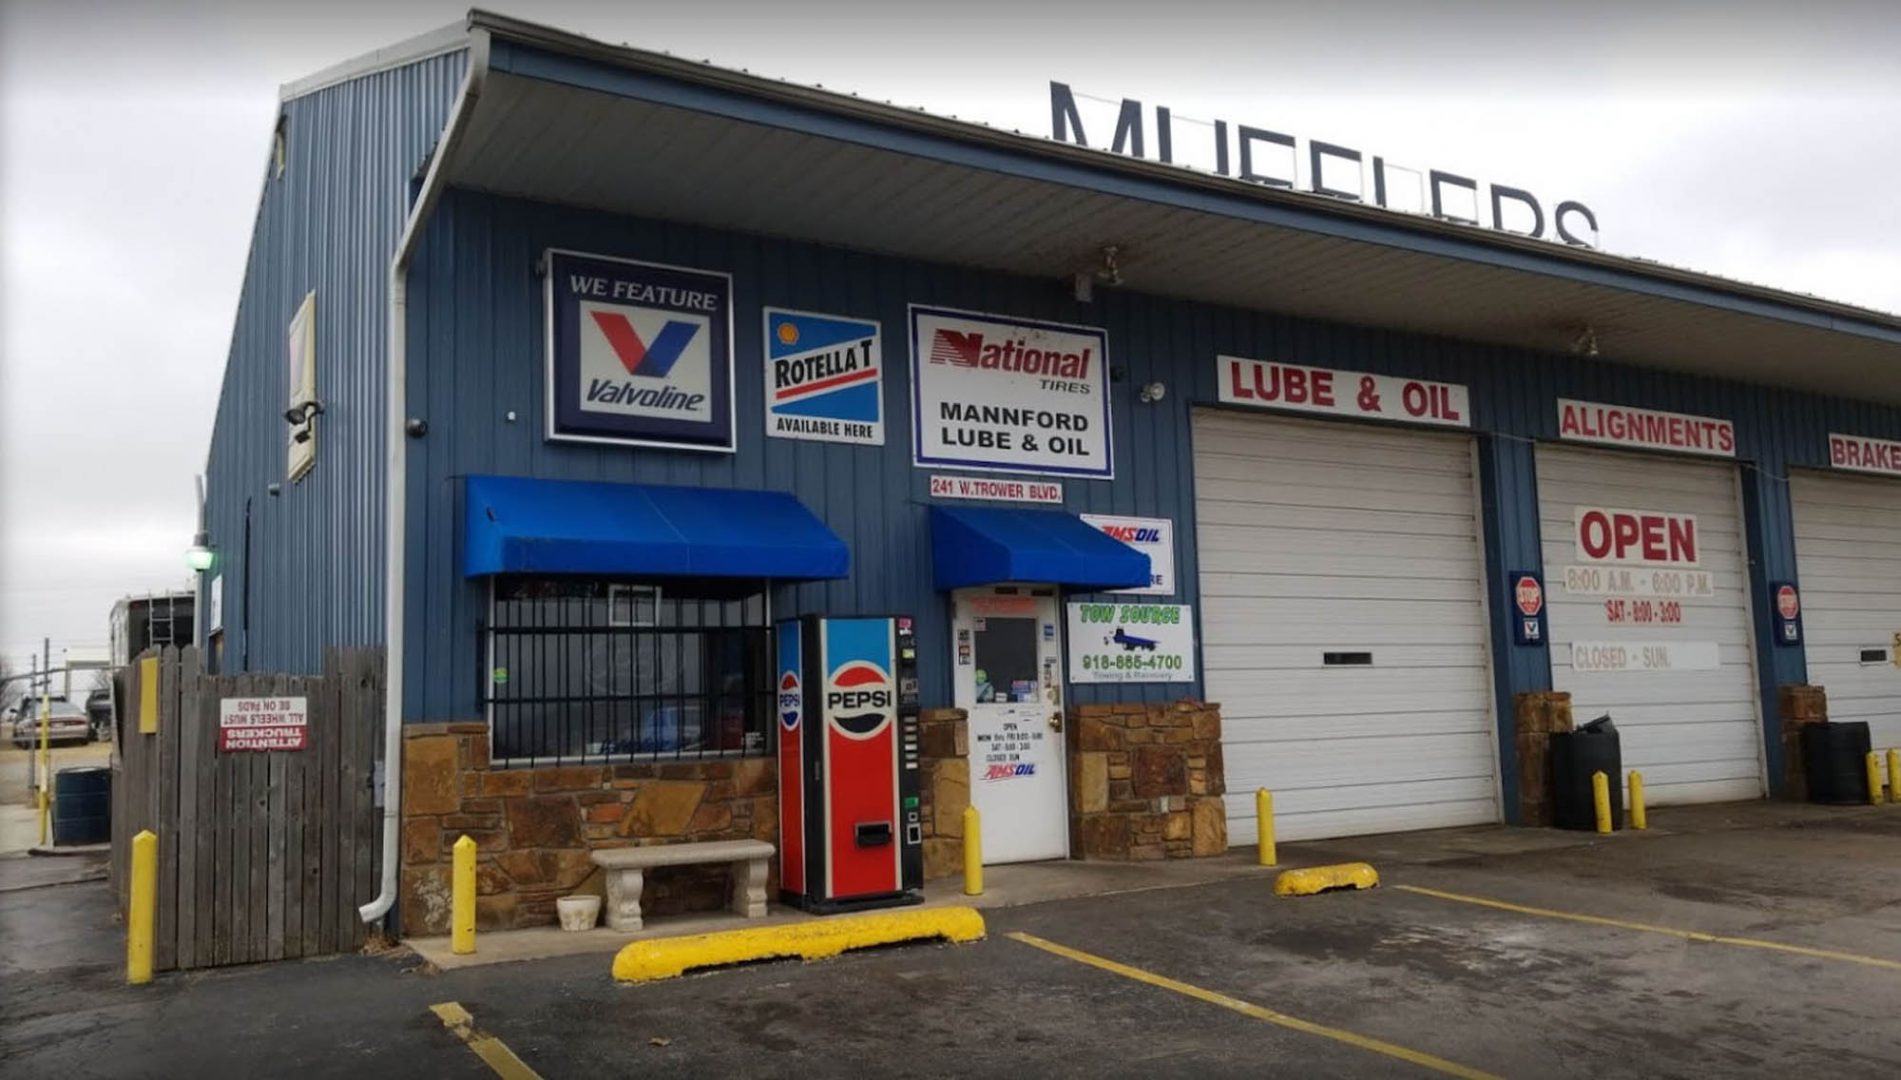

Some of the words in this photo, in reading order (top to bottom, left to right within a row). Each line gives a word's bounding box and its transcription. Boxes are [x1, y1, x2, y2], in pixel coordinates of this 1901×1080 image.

[570, 275, 608, 296] WE
[613, 280, 718, 311] FEATURE
[775, 347, 857, 388] ROTELLA
[861, 339, 872, 367] T
[930, 328, 1090, 379] National
[587, 378, 705, 411] Valvoline
[1040, 379, 1091, 395] TIRES
[1231, 361, 1335, 407] LUBE
[1357, 376, 1382, 412] &
[1402, 382, 1459, 421] OIL
[777, 418, 840, 436] AVAILABLE
[844, 423, 873, 438] HERE
[940, 402, 1089, 432] MANNFORD
[1561, 404, 1733, 451] ALIGNMENTS
[942, 427, 1011, 450] LUBE
[1022, 434, 1039, 452] &
[1048, 437, 1090, 456] OIL
[932, 479, 953, 495] 241
[1029, 485, 1061, 500] BLVD.
[1580, 511, 1696, 562] OPEN
[1567, 569, 1600, 590] 8:00
[1080, 605, 1115, 623] TOW
[1120, 605, 1180, 625] SOURCE
[1607, 600, 1625, 622] SAT
[1575, 646, 1627, 668] CLOSED
[827, 690, 891, 710] PEPSI
[225, 738, 302, 749] ATTENTION
